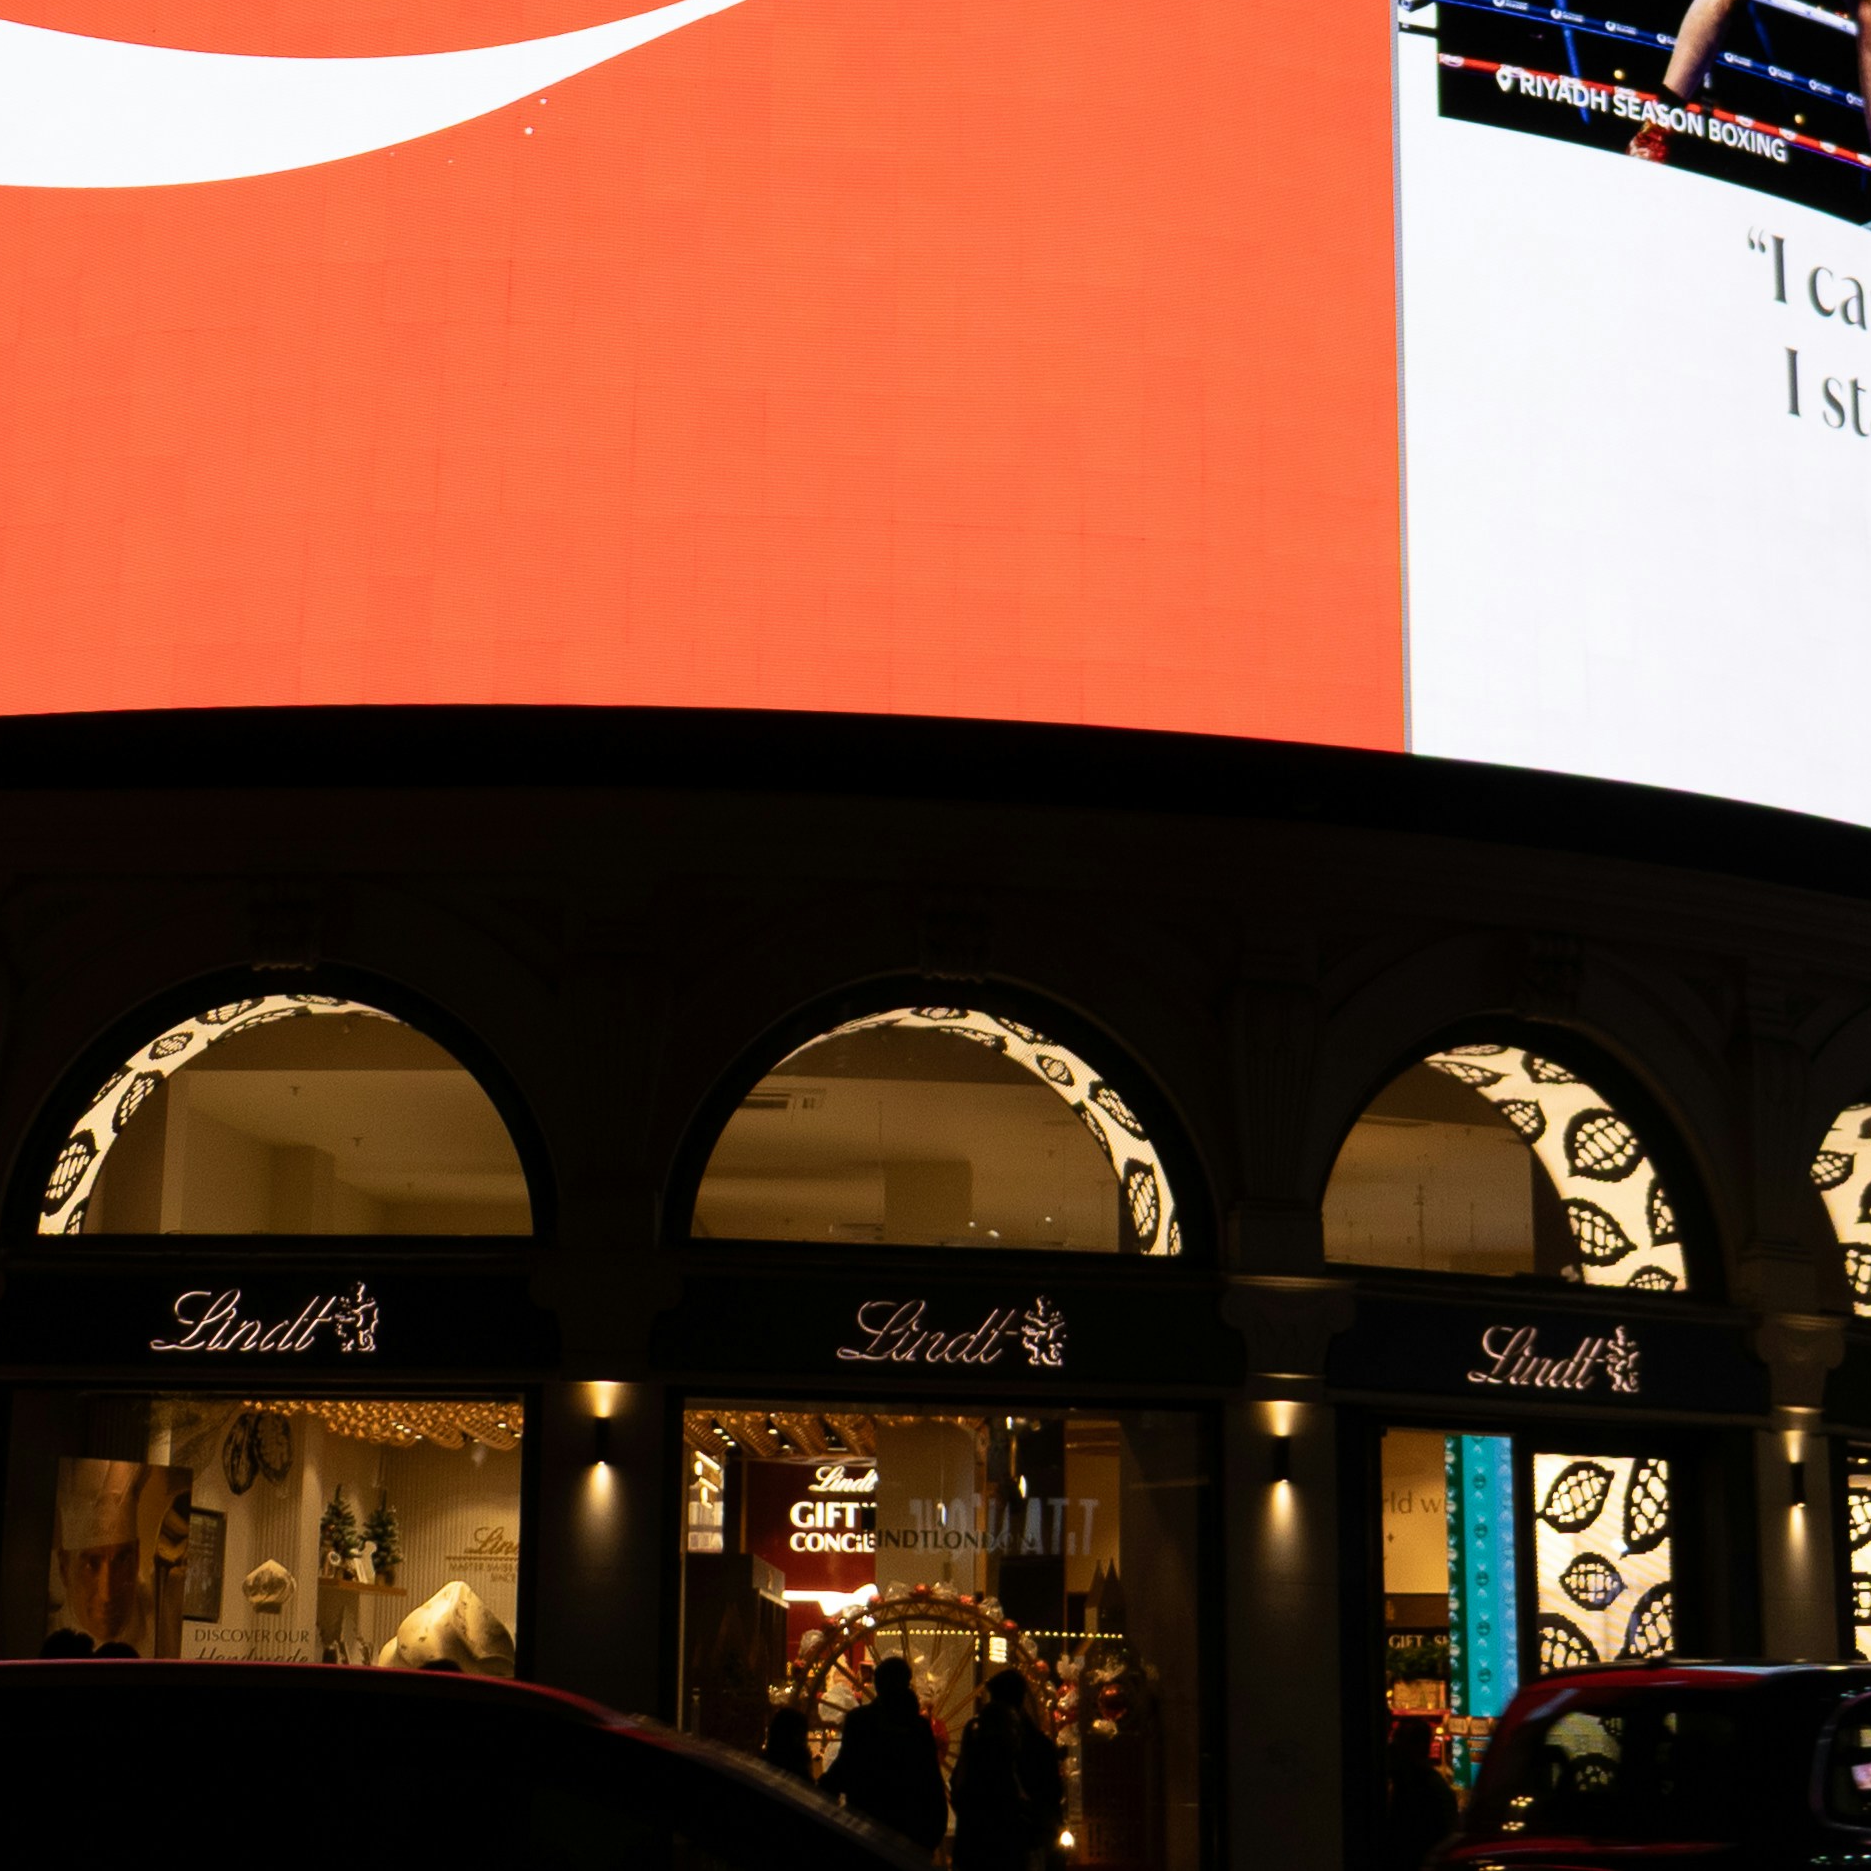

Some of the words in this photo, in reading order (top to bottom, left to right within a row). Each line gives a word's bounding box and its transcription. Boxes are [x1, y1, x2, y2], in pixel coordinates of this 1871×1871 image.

[1519, 71, 1608, 113] RIYADH
[1612, 93, 1704, 139] SEASON
[1708, 117, 1790, 164] BOXING
[1785, 346, 1802, 418] I
[149, 1287, 336, 1353] Lindt
[836, 1298, 1023, 1366] Lindt
[1466, 1325, 1606, 1391] Lindt
[808, 1465, 879, 1493] Lindt
[789, 1501, 860, 1529] GIFT
[464, 1526, 518, 1555] Lin
[194, 1629, 271, 1643] DISCOVER
[274, 1630, 310, 1644] OUR
[1388, 1634, 1424, 1649] GIFT
